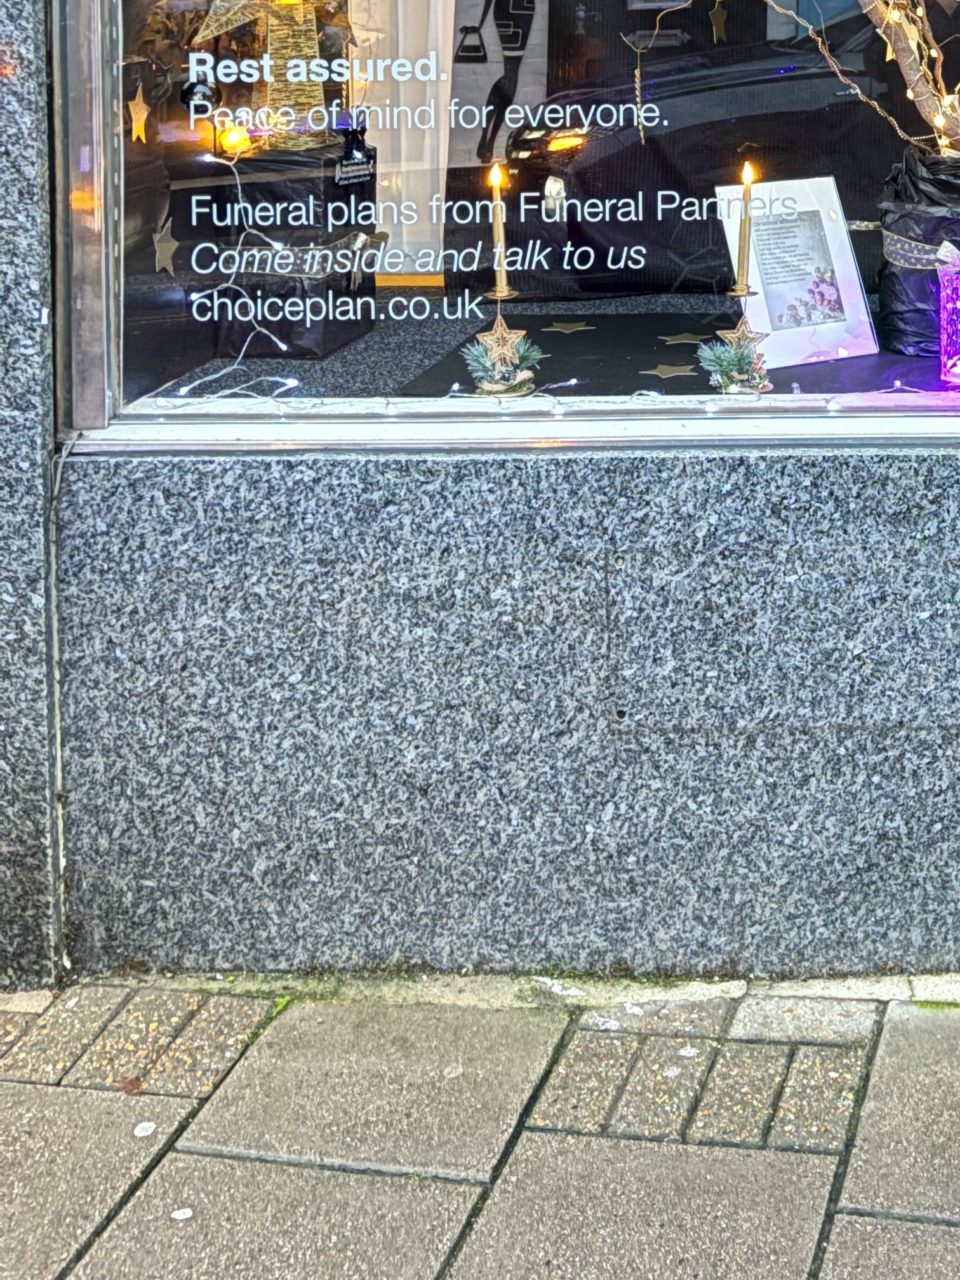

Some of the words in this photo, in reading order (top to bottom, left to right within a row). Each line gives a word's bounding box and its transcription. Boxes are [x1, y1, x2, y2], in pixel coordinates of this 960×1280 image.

[188, 51, 275, 84] Rest
[286, 50, 448, 82] assured.
[189, 100, 296, 130] Peace
[307, 99, 341, 129] of
[352, 99, 435, 129] mind
[448, 98, 494, 128] for
[504, 104, 669, 130] everyone.
[191, 195, 315, 226] Funeral
[327, 194, 418, 232] plans
[429, 194, 506, 224] from
[520, 191, 643, 222] Funeral
[656, 190, 798, 221] Partners
[191, 243, 295, 274] Come
[304, 241, 405, 273] inside
[415, 240, 483, 272] and
[493, 240, 557, 270] talk
[562, 243, 595, 270] to
[606, 247, 648, 270] us
[191, 288, 484, 328] choiceplan.co.uk
